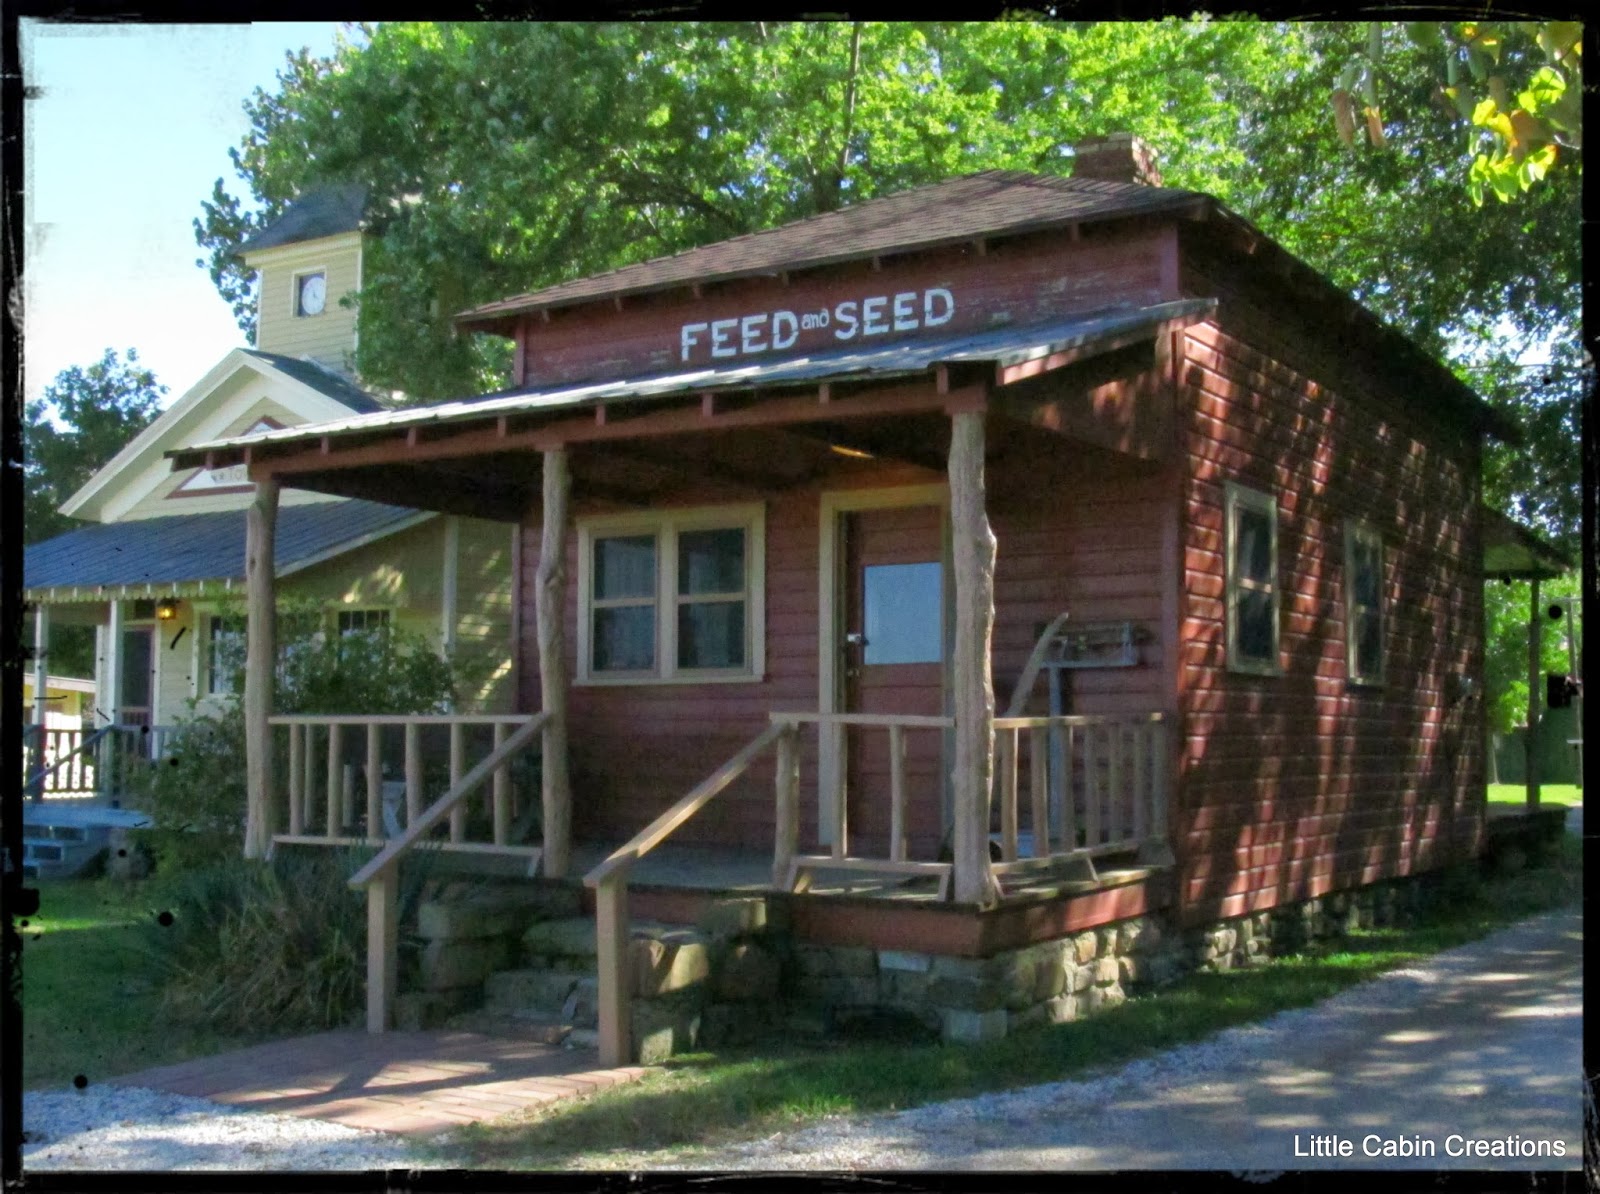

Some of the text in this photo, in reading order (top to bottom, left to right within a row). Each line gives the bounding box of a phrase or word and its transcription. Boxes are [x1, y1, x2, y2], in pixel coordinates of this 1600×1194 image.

[680, 288, 954, 361] FEED and SEED
